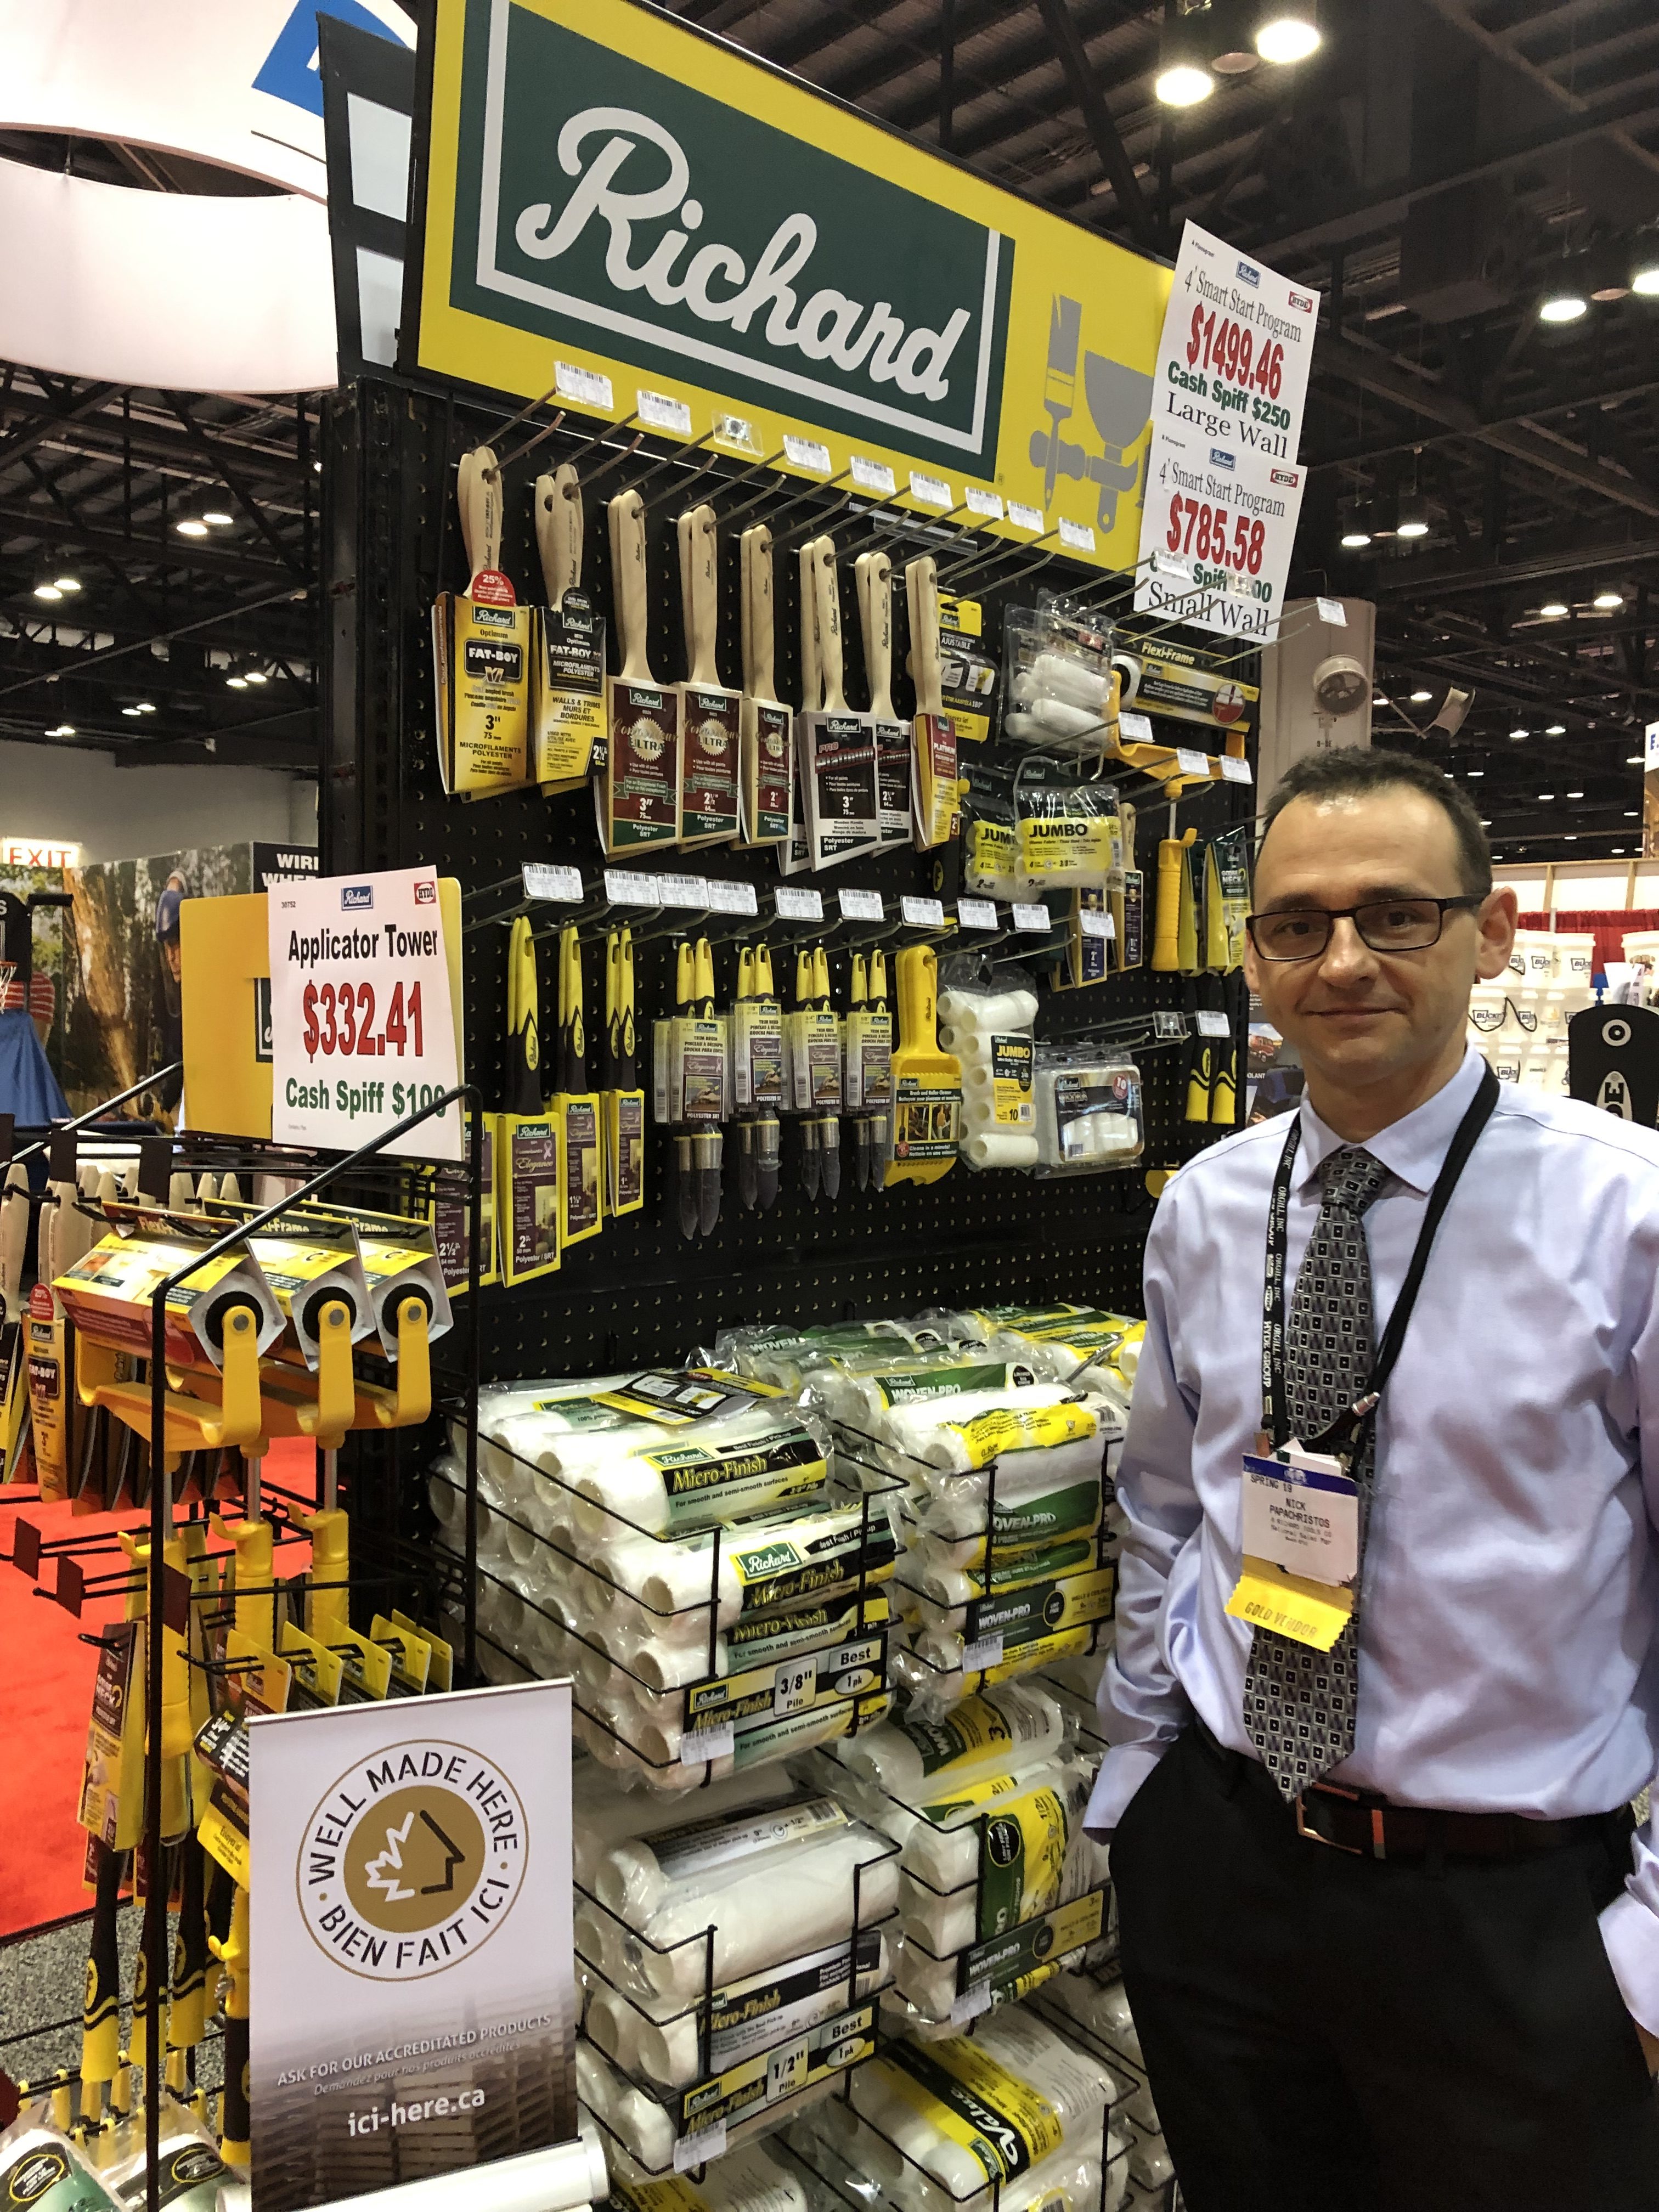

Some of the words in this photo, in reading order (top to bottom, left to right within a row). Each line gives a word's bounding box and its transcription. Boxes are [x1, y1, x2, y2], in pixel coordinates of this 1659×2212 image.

[516, 107, 970, 401] Richard
[1185, 266, 1198, 292] 4'
[1197, 270, 1229, 307] Smart
[1229, 288, 1255, 321] Start
[1256, 302, 1301, 343] Program
[1292, 296, 1308, 308] HYDE
[1186, 301, 1284, 400] $1499.46
[1168, 360, 1207, 397] Cash
[1211, 380, 1250, 413] Spiff
[1251, 396, 1291, 431] $250
[1166, 391, 1231, 437] Large
[1239, 420, 1288, 459] Wall
[1275, 472, 1294, 483] HYDE
[1159, 458, 1170, 485] 4'
[1172, 462, 1203, 494] Smart
[1206, 475, 1232, 503] Start
[1234, 484, 1285, 517] Program
[1166, 490, 1265, 575] $785.58
[483, 575, 504, 585] 25%
[1149, 581, 1212, 623] Small
[1218, 599, 1269, 636] Wall
[477, 610, 511, 624] Richard
[566, 618, 590, 630] Richard
[480, 629, 508, 639] Optimum
[550, 645, 591, 658] FAT-BOY
[941, 639, 970, 650] AJUSTABLE
[469, 647, 518, 663] FAT-BOY
[1142, 641, 1195, 665] Flexi-Frame
[553, 661, 600, 673] MICROFILAMENTS
[563, 668, 594, 677] POLYESTER
[485, 666, 505, 685] XL
[552, 697, 575, 705] WALLS
[584, 701, 601, 709] TRIMS
[632, 691, 659, 707] Richard
[702, 697, 725, 709] Richard
[486, 715, 500, 730] 3"
[561, 713, 595, 722] BORDURES
[830, 719, 858, 731] Richard
[877, 726, 899, 736] Richard
[460, 742, 521, 753] MICROFILAMENTS
[472, 750, 512, 759] POLYESTER
[819, 742, 839, 752] PRO
[640, 798, 653, 811] 3"
[843, 796, 854, 808] 3"
[697, 814, 724, 823] Polyester
[633, 823, 658, 833] Polyester
[1030, 824, 1087, 838] JUMBO
[824, 837, 854, 846] Polyester
[10, 847, 71, 867] EXIT
[345, 890, 371, 906] Richard
[418, 887, 435, 899] HYDE
[289, 927, 380, 968] Applicator
[385, 924, 438, 958] Tower
[303, 980, 424, 1063] $332.41
[996, 1045, 1030, 1058] JUMBO
[1117, 1076, 1126, 1090] 10
[285, 1079, 329, 1110] Cash
[336, 1081, 385, 1114] Spiff
[570, 1104, 591, 1113] Richard
[1009, 1109, 1018, 1121] 10
[520, 1126, 548, 1137] Richard
[516, 1157, 553, 1173] Elegance
[1276, 1217, 1285, 1232] INC
[516, 1254, 540, 1263] Polyester
[544, 1252, 554, 1260] SRT
[1263, 1321, 1272, 1349] HYDE
[1263, 1351, 1272, 1387] GROUP
[661, 1451, 704, 1464] Richard
[673, 1455, 768, 1492] Micro-Finish
[687, 1494, 711, 1506] smooth
[712, 1491, 723, 1499] and
[725, 1482, 763, 1497] semi-smooth
[764, 1476, 788, 1487] surfaces
[1251, 1474, 1279, 1490] SPRING
[1282, 1483, 1293, 1493] 19
[1285, 1498, 1306, 1511] NICK
[992, 1512, 1057, 1532] OVEN-PRO
[1269, 1505, 1330, 1528] PAPACHRISTOS
[748, 1551, 792, 1572] Richard
[748, 1559, 845, 1609] Micro-Finish
[979, 1604, 1031, 1630] WOVEN-PRO
[1245, 1601, 1272, 1621] GOLD
[1274, 1611, 1318, 1638] VENDOR
[748, 1645, 774, 1657] smooth
[776, 1641, 788, 1650] and
[790, 1629, 828, 1646] semi-smooth
[840, 1647, 871, 1666] Best
[780, 1669, 812, 1695] 3/8"
[693, 1691, 772, 1730] Micro-Finish
[786, 1697, 804, 1709] Pile
[752, 1734, 776, 1747] smooth
[777, 1729, 789, 1737] and
[791, 1717, 829, 1734] semi-smooth
[830, 1707, 853, 1720] surfaces
[308, 1793, 366, 1886] WELL
[365, 1752, 467, 1792] MADE
[466, 1770, 517, 1852] HERE
[319, 1905, 388, 1967] BIEN
[396, 1918, 467, 1969] FAIT
[471, 1878, 510, 1924] ICI
[832, 2016, 863, 2039] Best
[278, 2068, 307, 2086] ASK
[309, 2061, 338, 2079] FOR
[341, 2053, 373, 2072] OUR
[375, 2030, 477, 2064] ACCREDITATED
[479, 2015, 552, 2041] PRODUCTS
[774, 2050, 804, 2079] 1/2"
[314, 2072, 373, 2096] Demandez
[373, 2069, 401, 2085] pour
[402, 2064, 421, 2075] nos
[422, 2052, 467, 2073] produits
[779, 2079, 796, 2093] Pile
[348, 2088, 486, 2137] ici-here.ca
[688, 2078, 764, 2133] Micro-Finish
